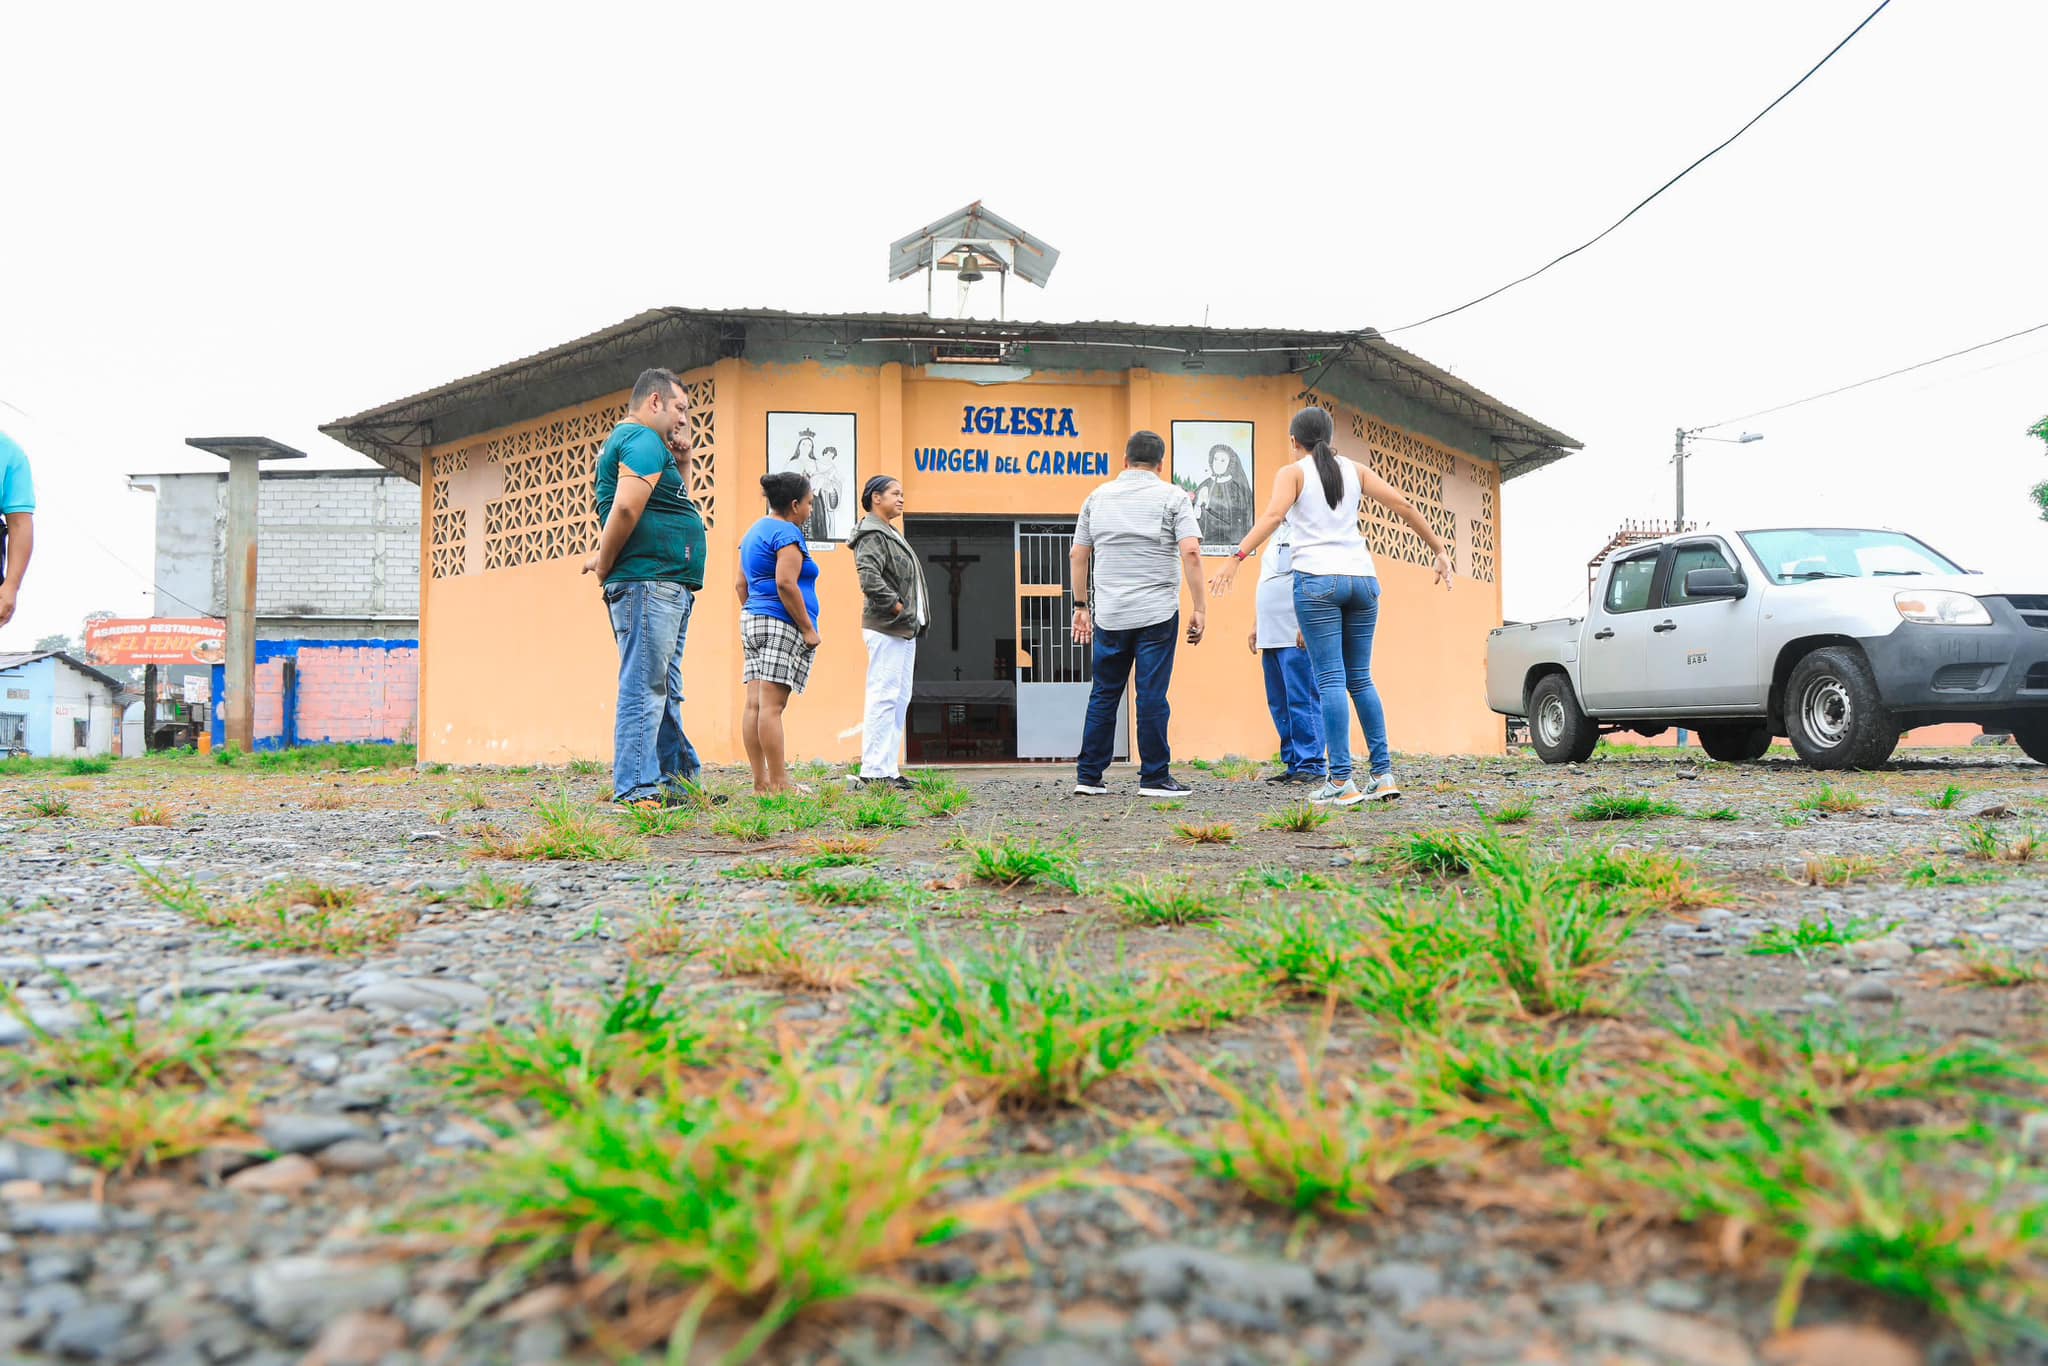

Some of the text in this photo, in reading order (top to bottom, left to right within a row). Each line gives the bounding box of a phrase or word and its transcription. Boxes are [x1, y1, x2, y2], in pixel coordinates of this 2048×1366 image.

[961, 405, 1079, 437] IGLESIA
[914, 447, 1109, 475] VIRGEN DEL CARMEN
[93, 624, 146, 638] ASADERO
[117, 635, 139, 651] EL
